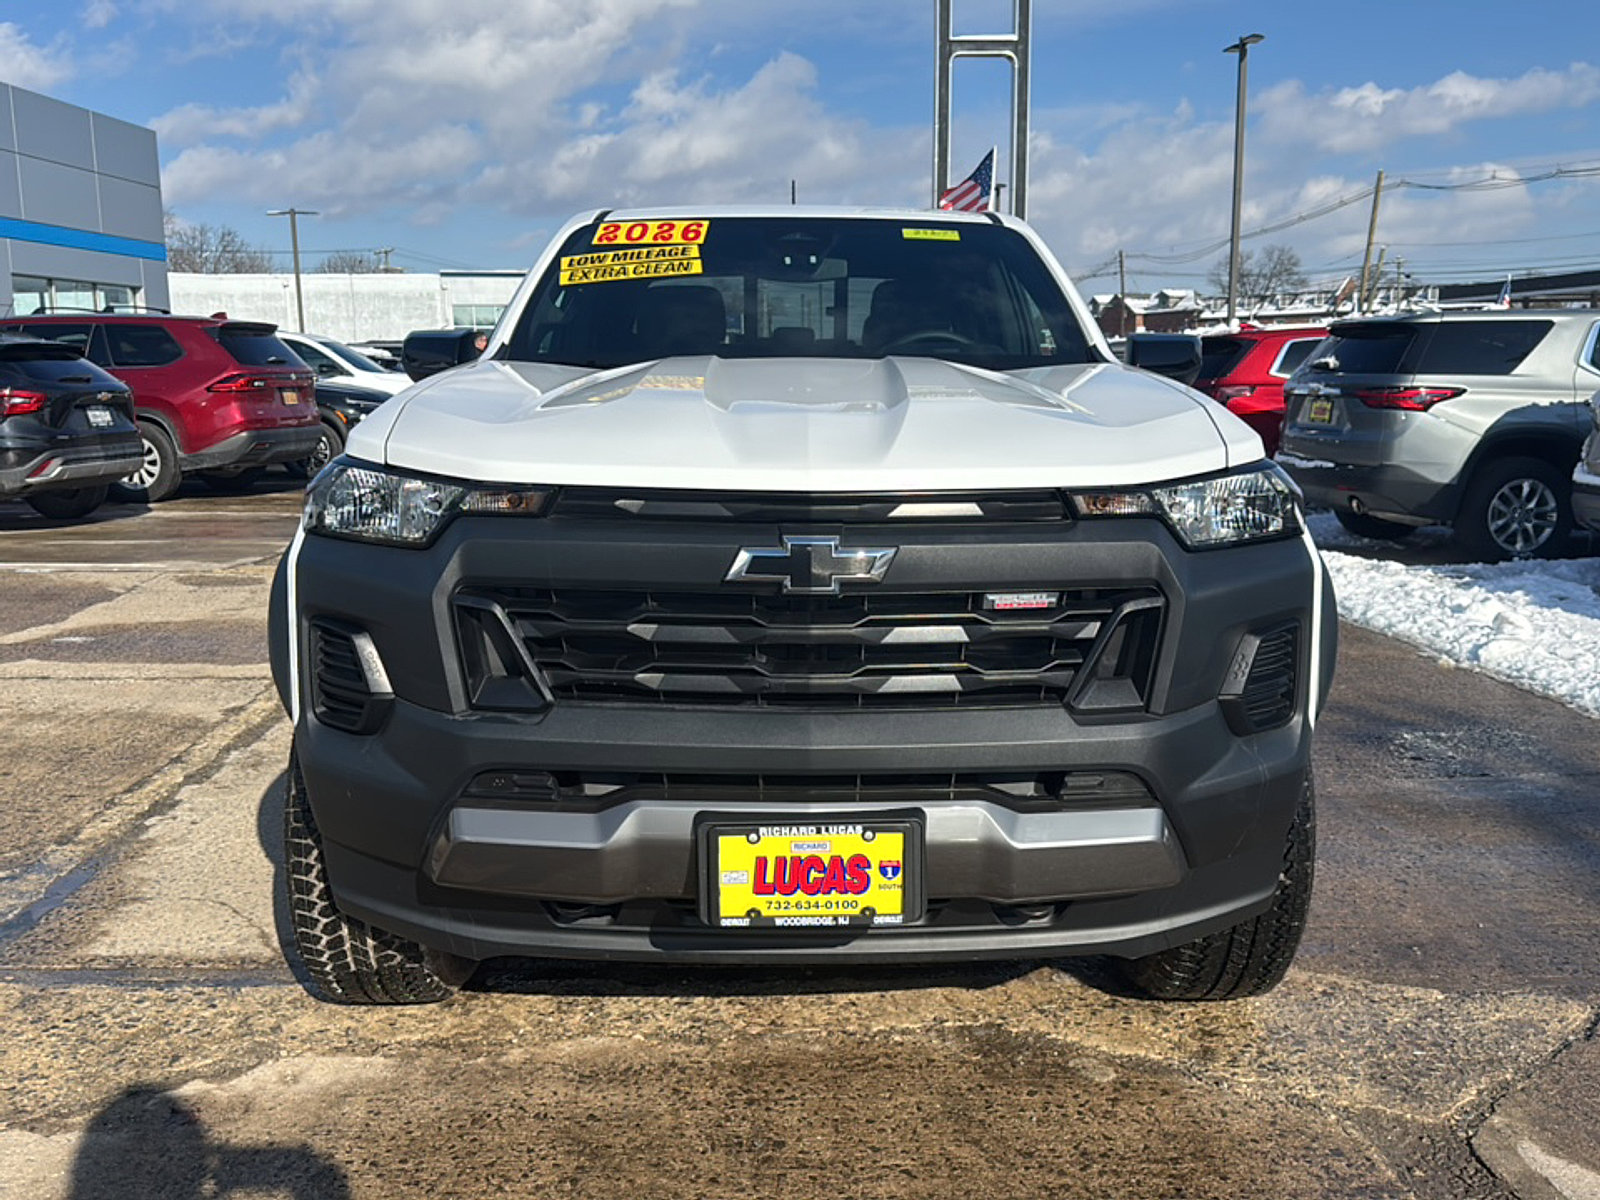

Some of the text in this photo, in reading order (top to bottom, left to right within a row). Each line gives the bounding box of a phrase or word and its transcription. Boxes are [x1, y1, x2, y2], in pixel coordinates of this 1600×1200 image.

[597, 223, 704, 243] 2026
[567, 246, 694, 267] LOW MILEAGE
[567, 261, 691, 282] EXTRA CLEAN
[759, 825, 863, 837] RICHARD LUCAS
[753, 854, 871, 895] LUCAS
[765, 899, 859, 910] 732-634-0100
